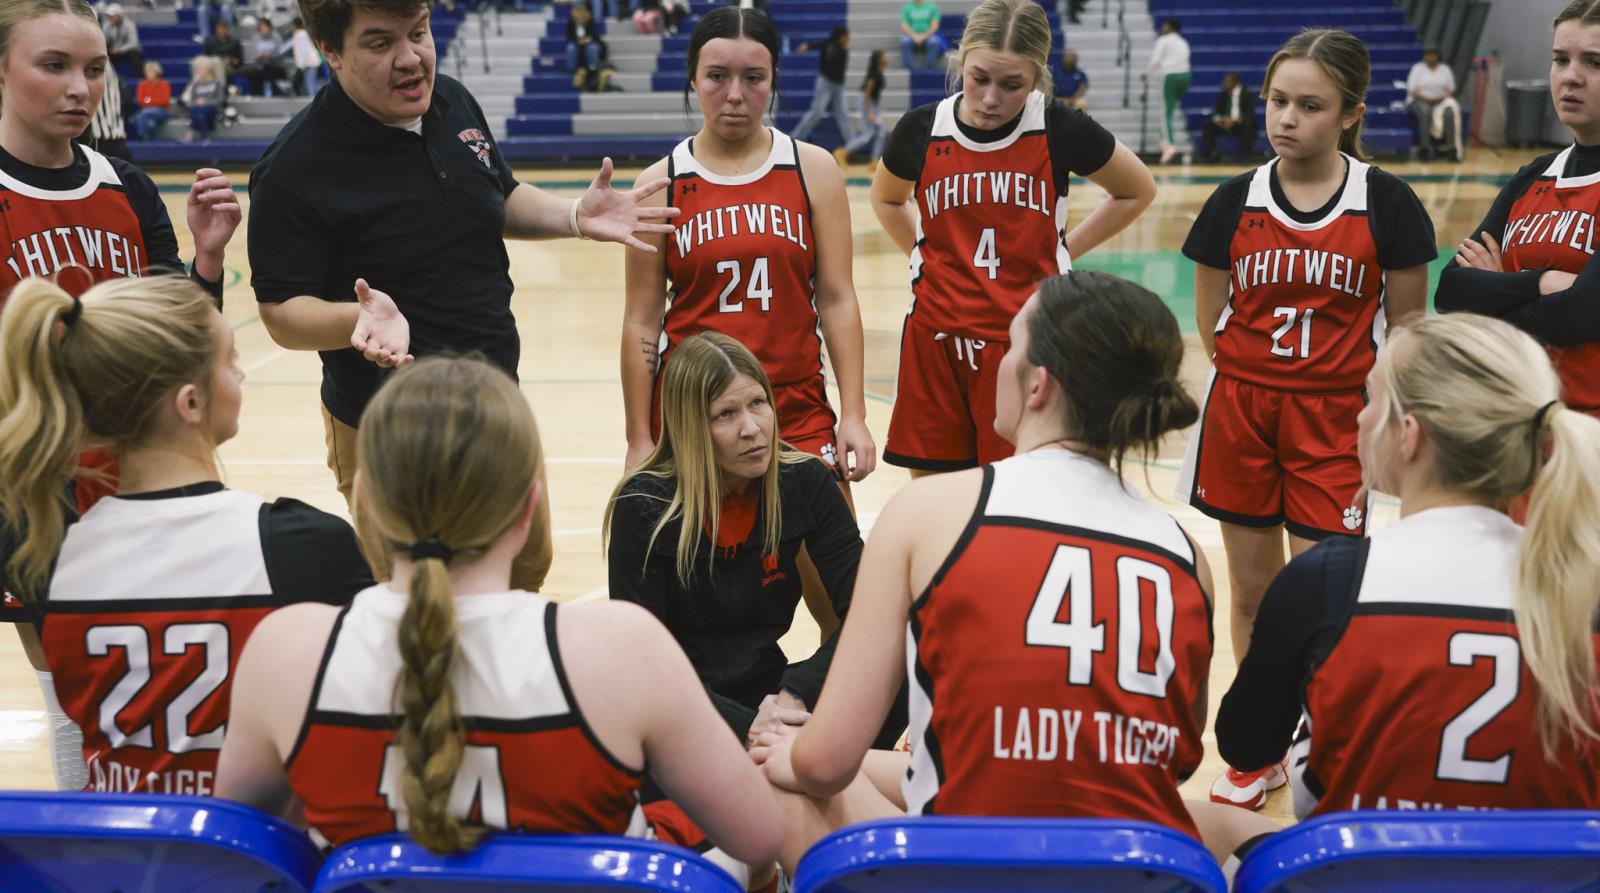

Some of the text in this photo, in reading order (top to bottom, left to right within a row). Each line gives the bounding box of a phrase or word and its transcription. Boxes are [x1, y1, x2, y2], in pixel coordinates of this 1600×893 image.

[924, 171, 1050, 220] WHITWELL
[674, 203, 808, 259] WHITWELL
[973, 227, 1001, 280] 4
[716, 257, 773, 313] 24
[1235, 248, 1366, 298] WHITWELL
[1270, 306, 1315, 359] 21
[1025, 543, 1176, 698] 40
[86, 622, 229, 754] 22
[1436, 632, 1520, 784] 2
[993, 706, 1082, 762] LADY
